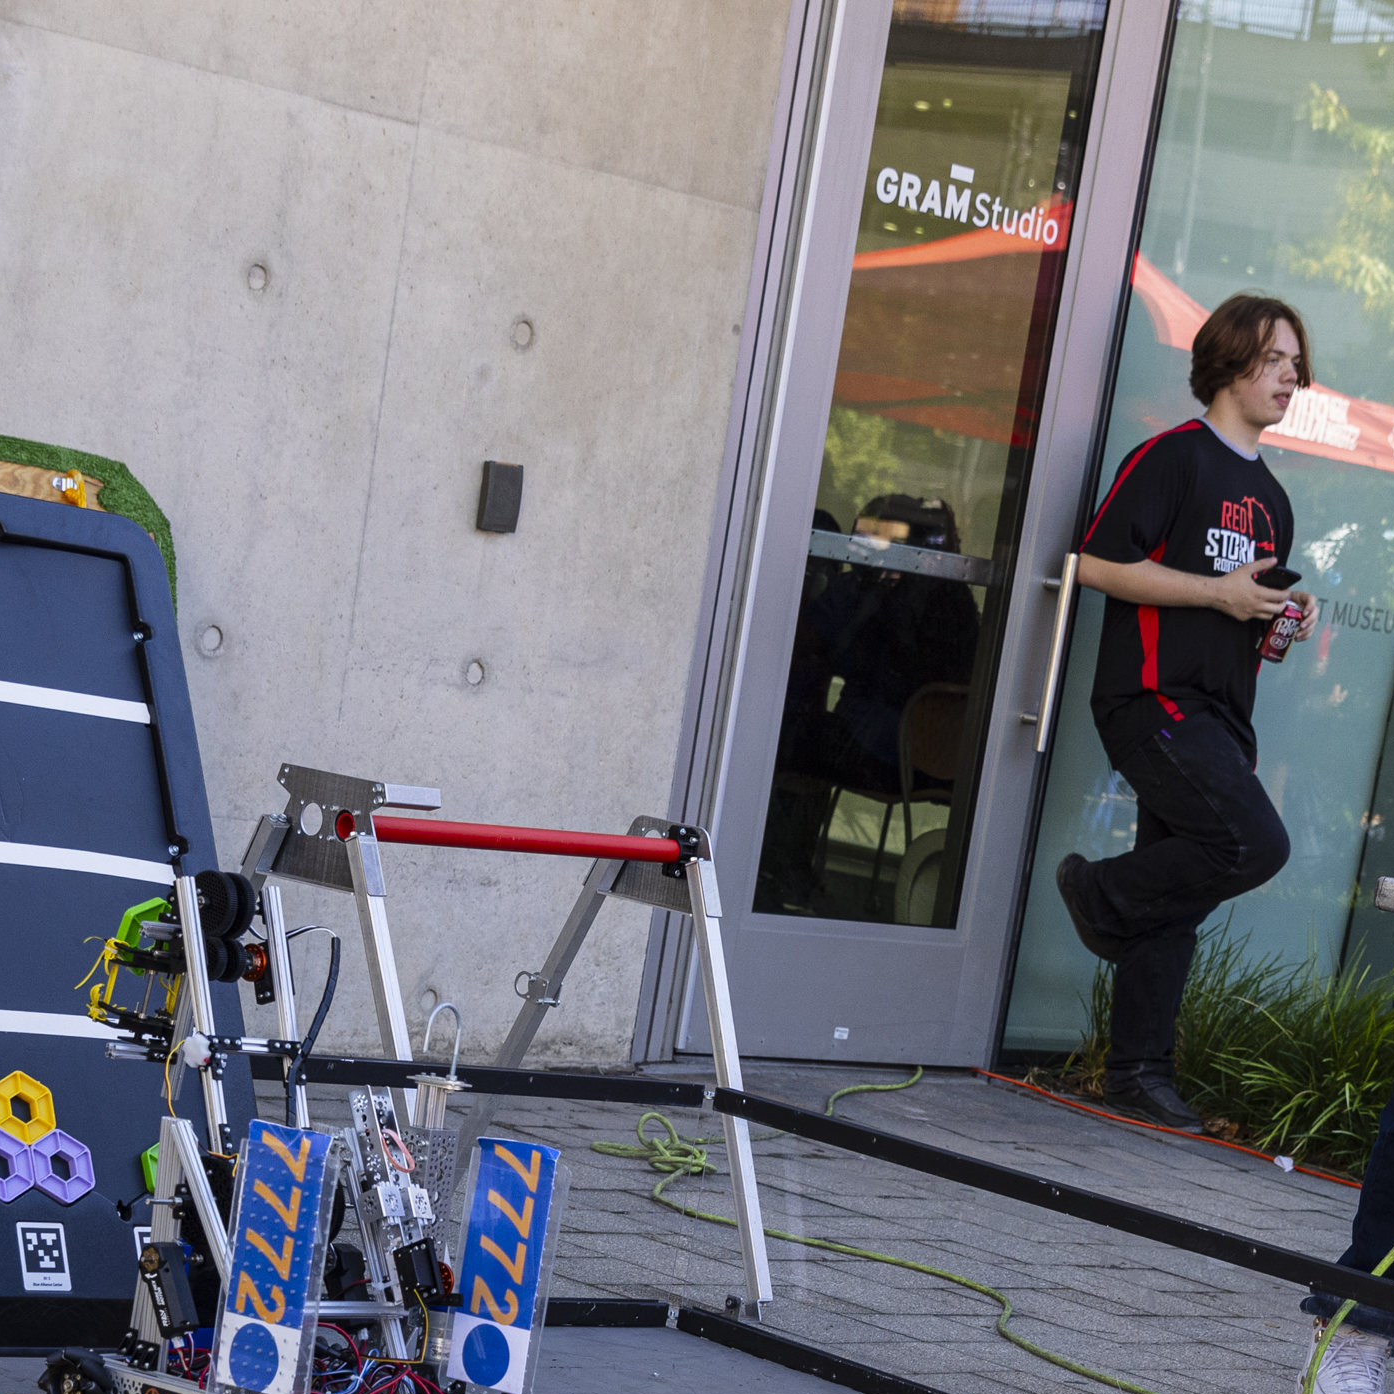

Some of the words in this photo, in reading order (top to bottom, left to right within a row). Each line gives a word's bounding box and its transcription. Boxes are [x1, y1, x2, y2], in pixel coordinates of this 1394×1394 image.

[876, 166, 972, 224] GRAM
[972, 192, 1059, 246] Studio
[1204, 527, 1256, 565] STORM
[1221, 500, 1247, 534] RED
[235, 1129, 311, 1324] 7772
[470, 1143, 541, 1325] 7772
